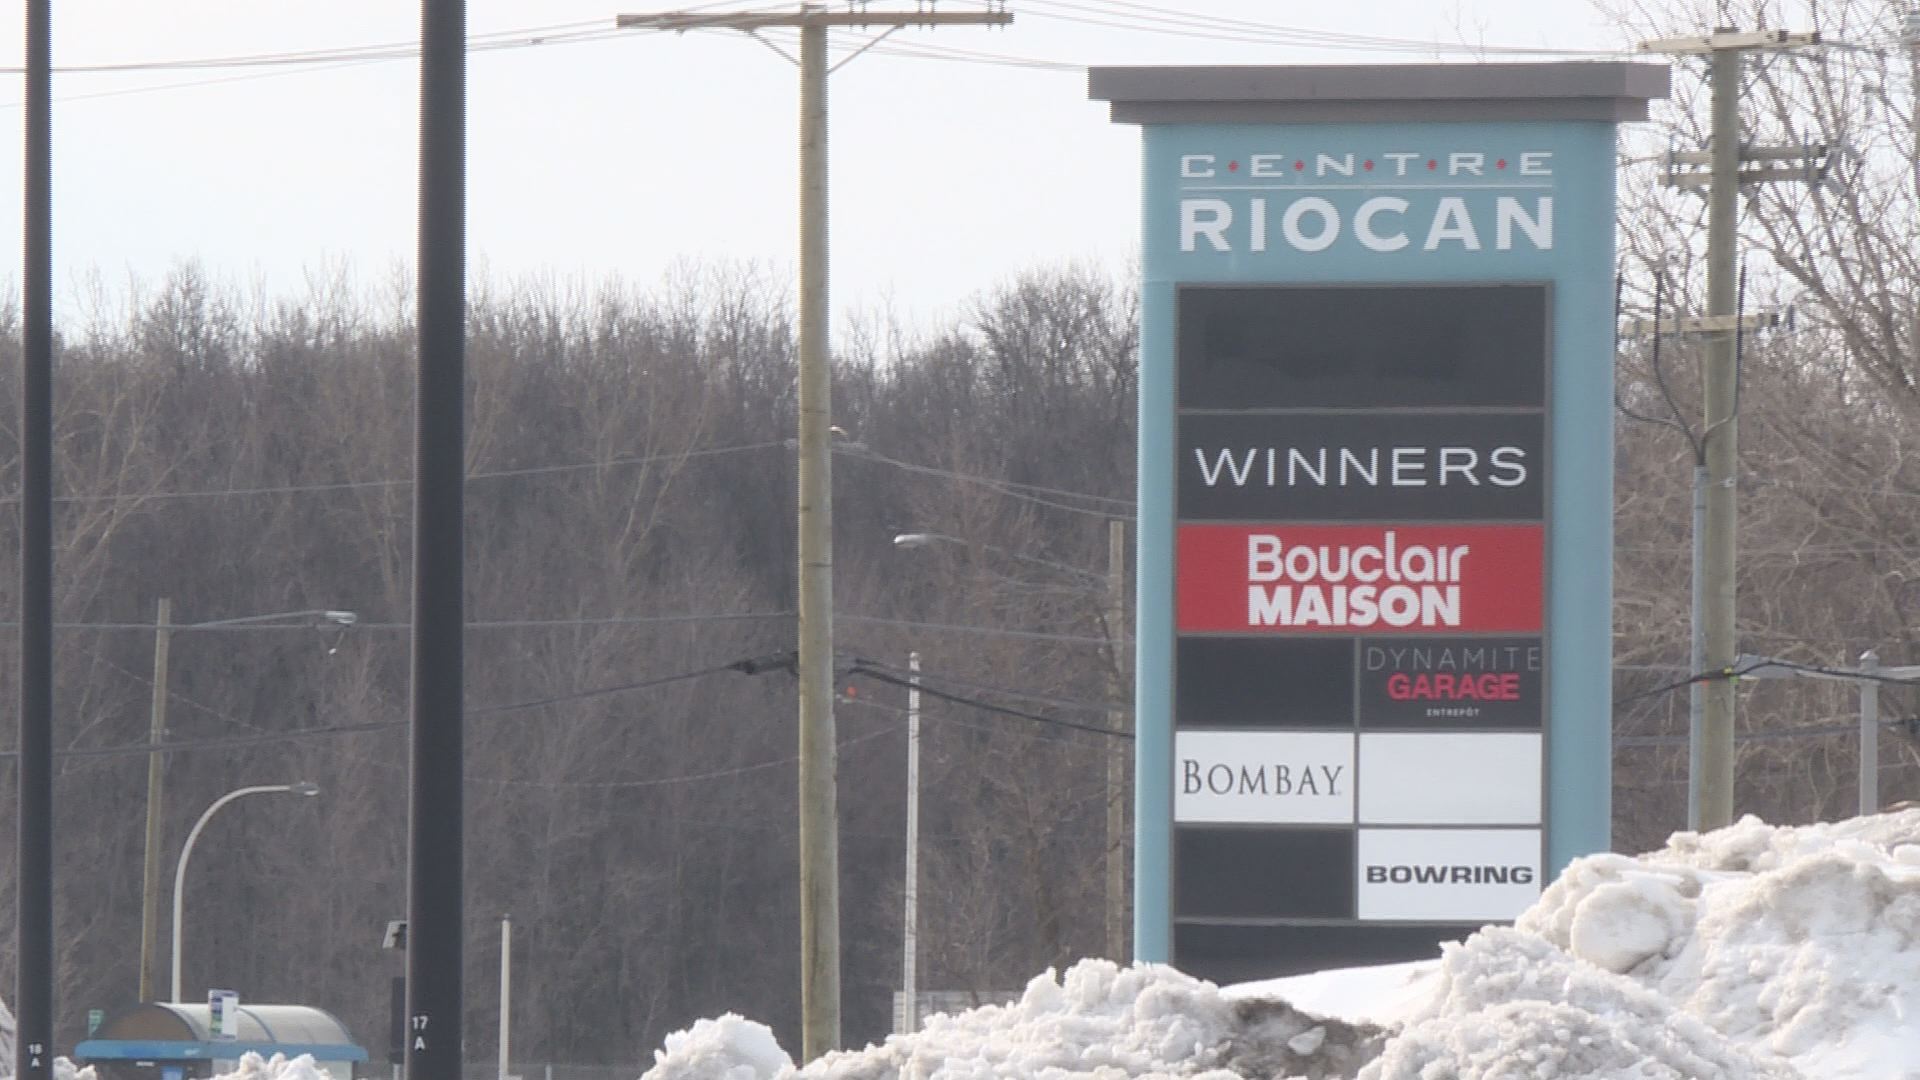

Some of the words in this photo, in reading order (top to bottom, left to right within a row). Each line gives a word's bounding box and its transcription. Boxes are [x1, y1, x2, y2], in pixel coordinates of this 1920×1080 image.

[1180, 197, 1553, 251] RIOCAN
[1195, 447, 1527, 487] WINNERS
[1248, 530, 1469, 582] Bouclair
[1248, 585, 1460, 626] MAISON
[1366, 647, 1540, 671] DYNAMITE
[1387, 673, 1520, 700] GARAGE
[1183, 759, 1343, 796] BOMBAY
[1366, 865, 1534, 884] BOWRING
[412, 1015, 428, 1030] 17
[414, 1036, 425, 1050] A
